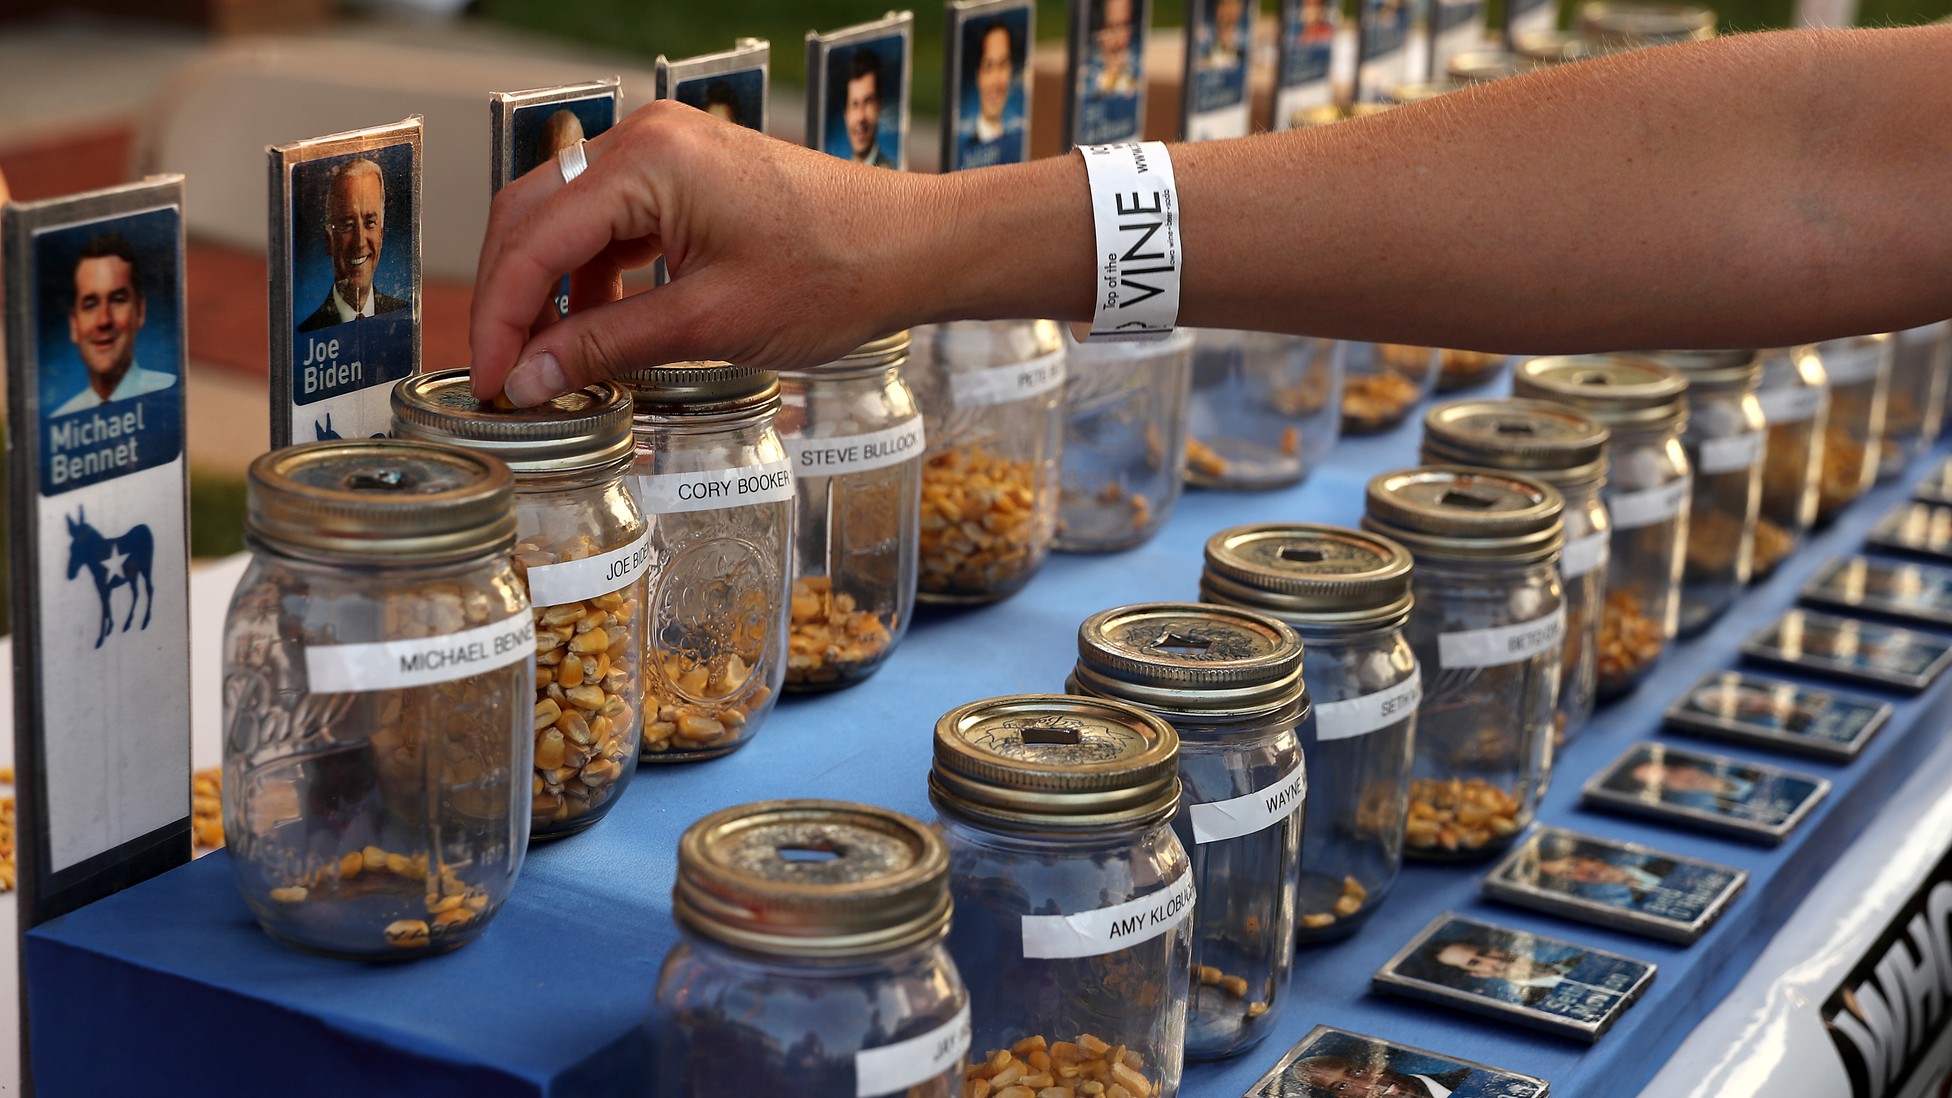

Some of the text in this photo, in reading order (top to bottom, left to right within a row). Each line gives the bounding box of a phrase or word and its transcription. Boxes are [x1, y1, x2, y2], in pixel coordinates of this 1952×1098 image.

[1115, 191, 1175, 309] VINE
[1103, 252, 1119, 310] Top of the
[303, 338, 340, 366] Joe
[304, 360, 362, 395] Biden
[50, 402, 145, 454] Michael
[801, 431, 918, 466] STEVE BULLOCK
[51, 436, 138, 485] Bennet
[678, 470, 790, 500] CORY BOOKER
[606, 542, 649, 581] JOE BIDE
[401, 619, 535, 672] MICHAEL BENNE
[1266, 776, 1302, 813] WAYNE
[1109, 881, 1194, 939] AMY KLOBUC
